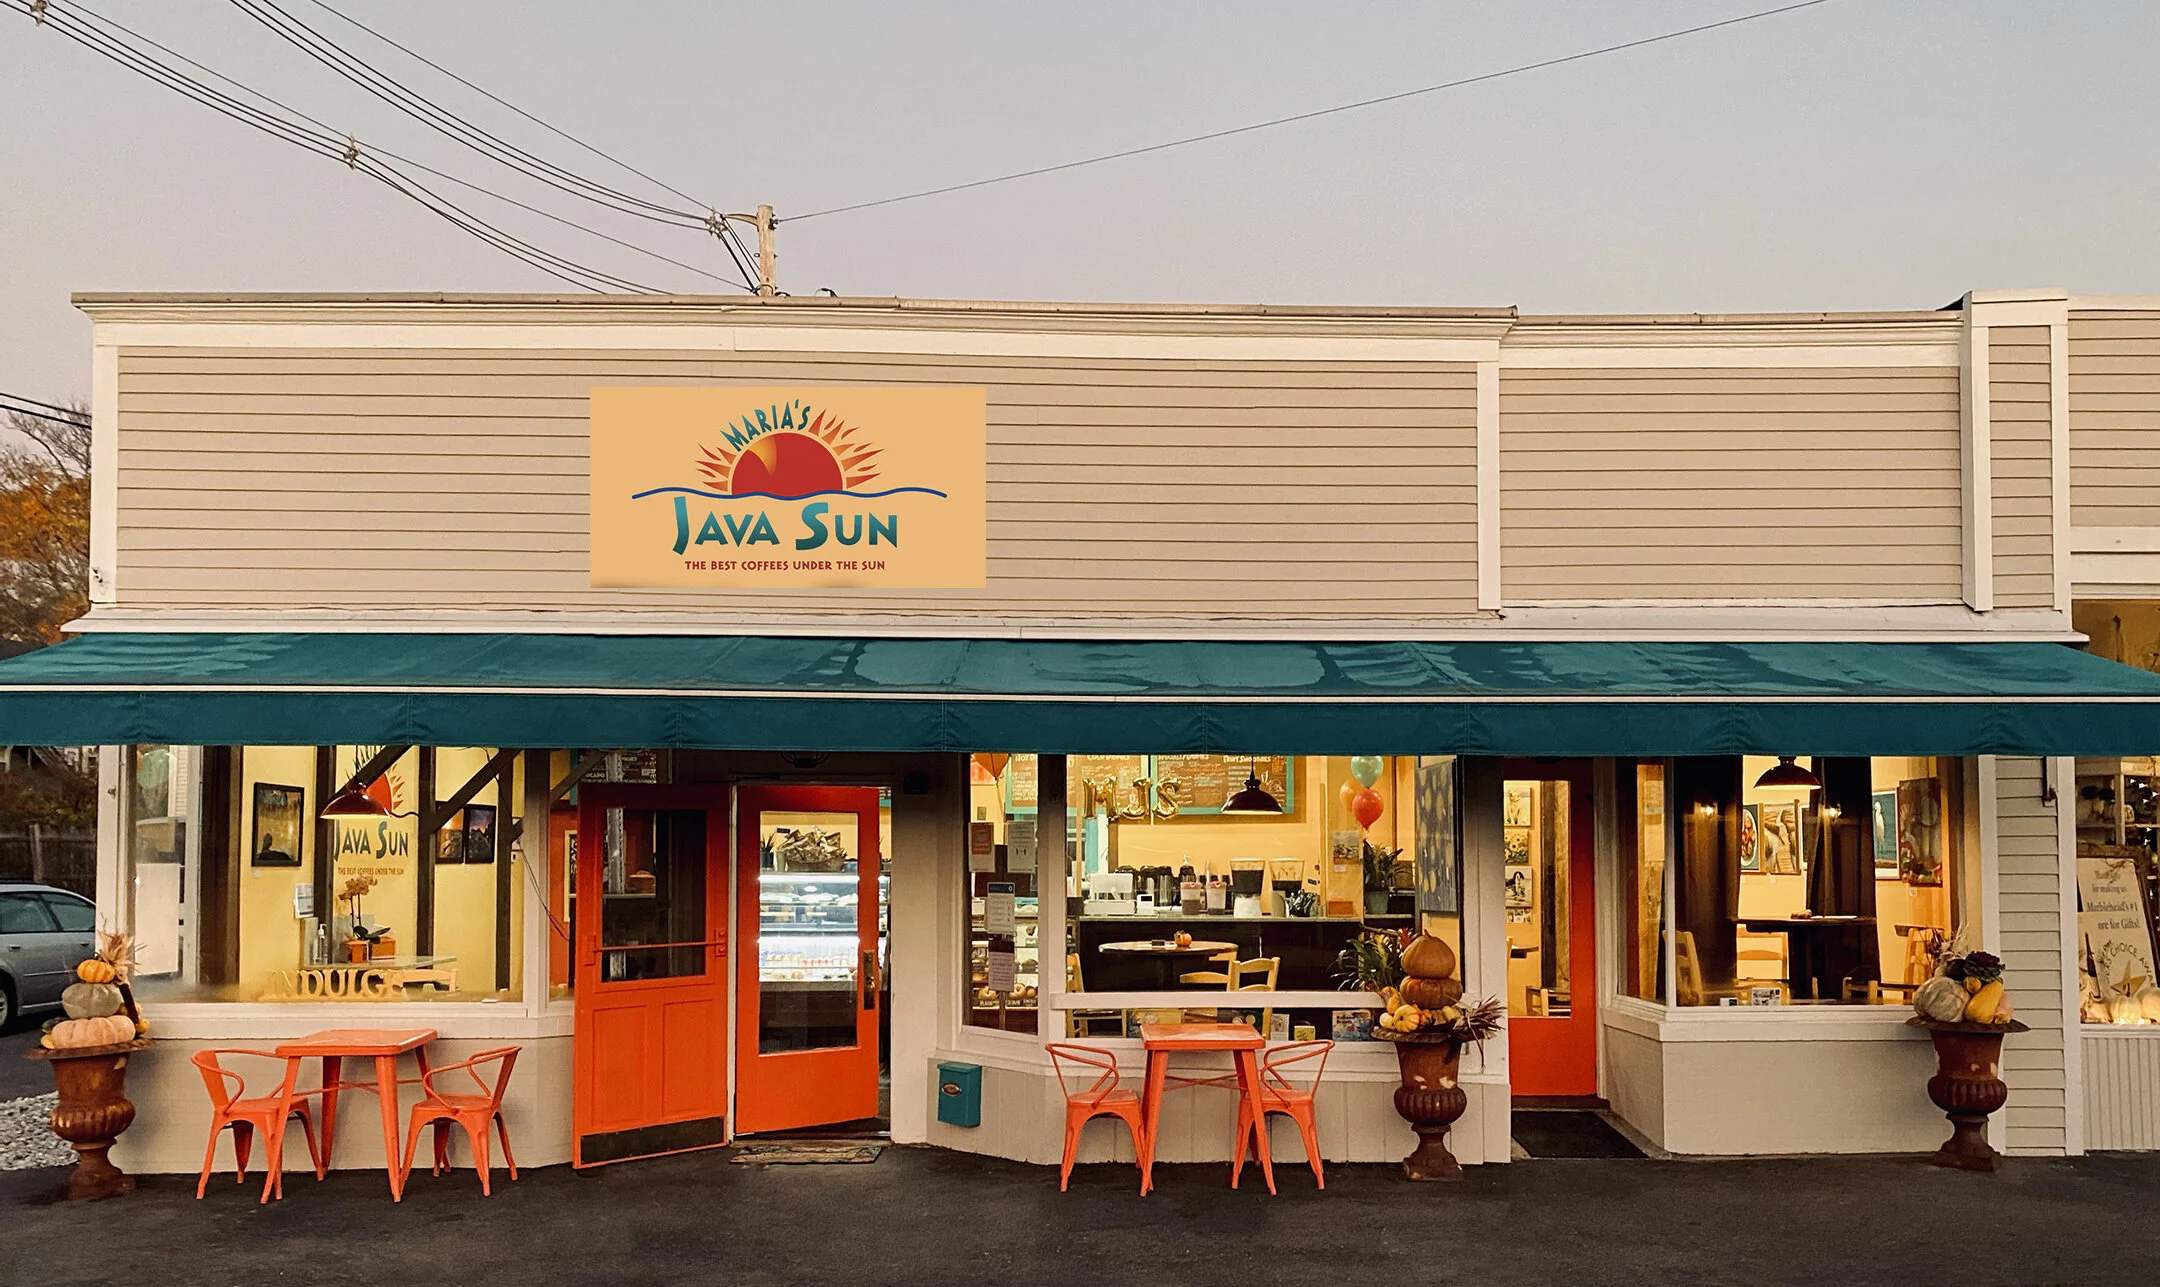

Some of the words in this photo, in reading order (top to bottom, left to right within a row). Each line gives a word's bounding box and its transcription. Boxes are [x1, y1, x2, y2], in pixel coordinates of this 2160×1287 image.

[720, 398, 811, 452] MARIA'S
[685, 560, 706, 571] THE
[710, 560, 737, 571] BEST
[741, 560, 788, 571] COFFEES
[793, 560, 832, 571] UNDER
[836, 560, 858, 571] THE
[861, 560, 885, 571] SUN
[2110, 942, 2137, 957] CHOICE
